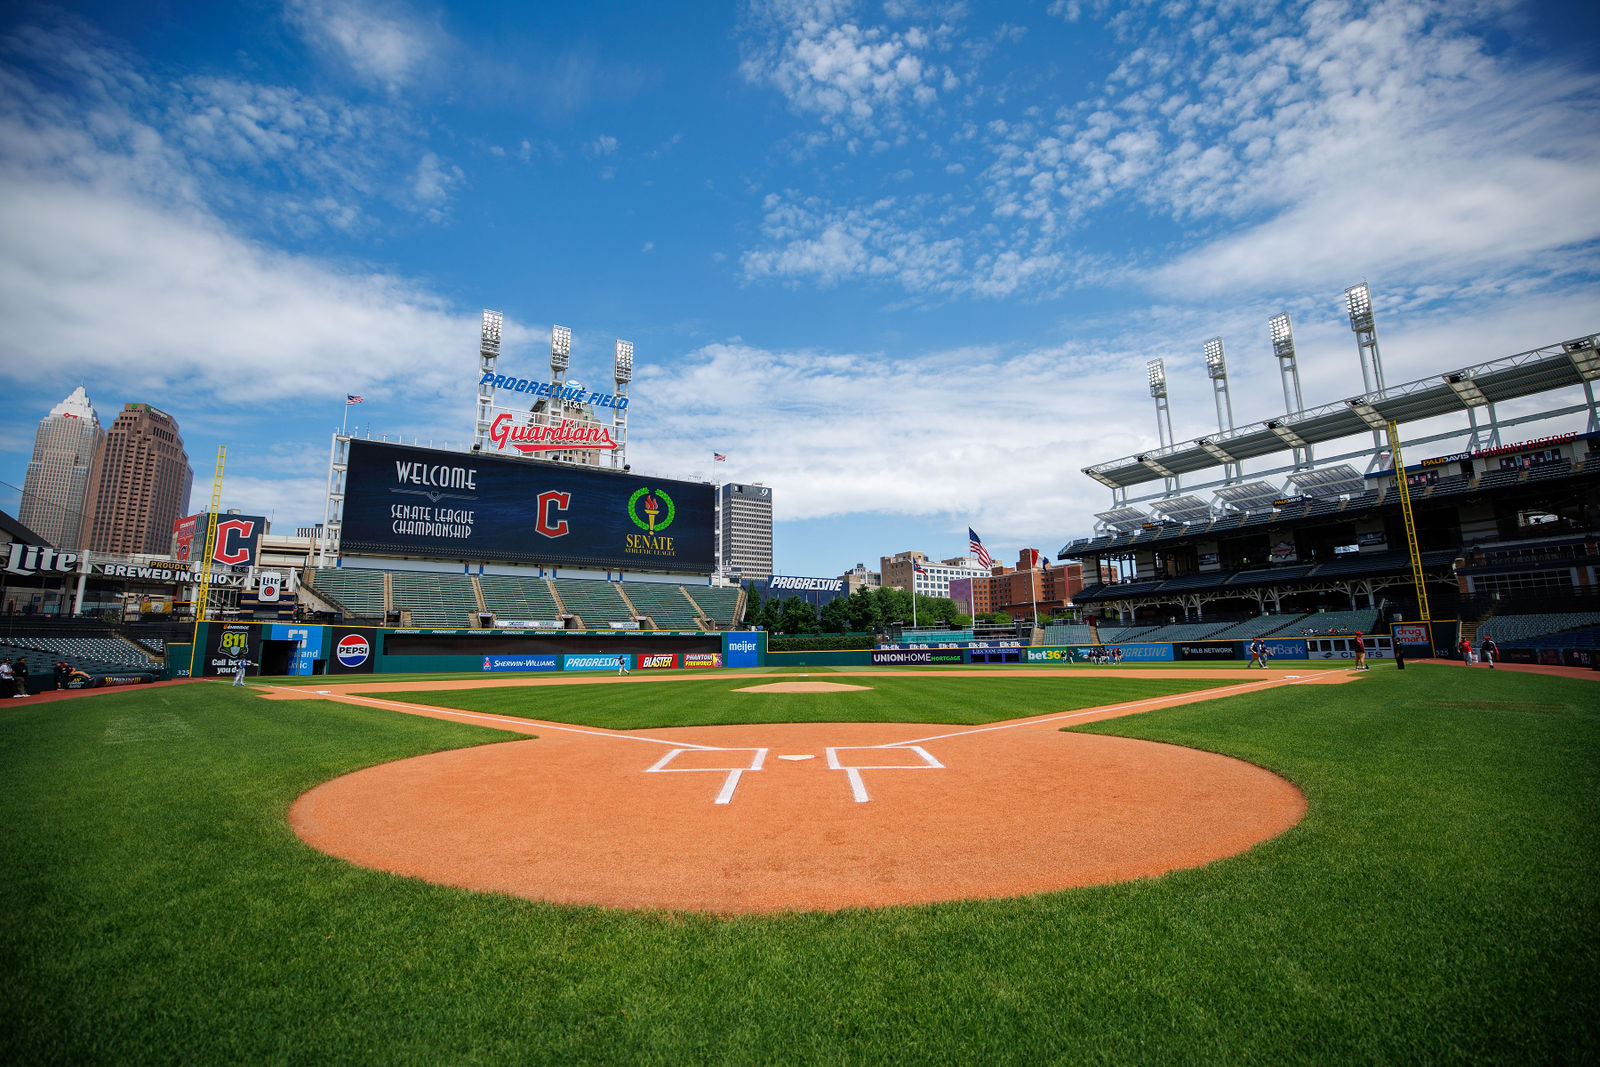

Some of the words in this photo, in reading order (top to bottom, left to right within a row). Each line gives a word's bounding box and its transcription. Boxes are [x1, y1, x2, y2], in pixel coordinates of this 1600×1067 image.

[480, 372, 587, 403] PROGRESSIVE
[588, 392, 629, 409] FIELD
[490, 413, 618, 453] Guardians
[1527, 431, 1579, 450] DISTRICT
[396, 460, 477, 490] WELCOME
[391, 504, 432, 521] SENATE
[434, 508, 475, 525] LEAGUE
[535, 490, 571, 539] C
[392, 519, 472, 539] CHAMPIONSHIP
[212, 518, 255, 566] C
[626, 533, 675, 551] SENATE
[3, 542, 77, 576] Lite
[150, 561, 190, 571] PROUDLY
[103, 564, 171, 580] BREWED
[174, 570, 190, 582] IN
[262, 576, 280, 586] Lite
[770, 576, 843, 591] PROGRESSIVE
[1397, 625, 1421, 637] drug
[222, 632, 246, 648] 811
[729, 641, 756, 653] meijer
[338, 646, 368, 655] PEPSI
[1027, 650, 1067, 660] bet36
[565, 657, 628, 668] PROGRESSIV
[643, 656, 673, 668] BLASTER
[217, 667, 231, 675] you
